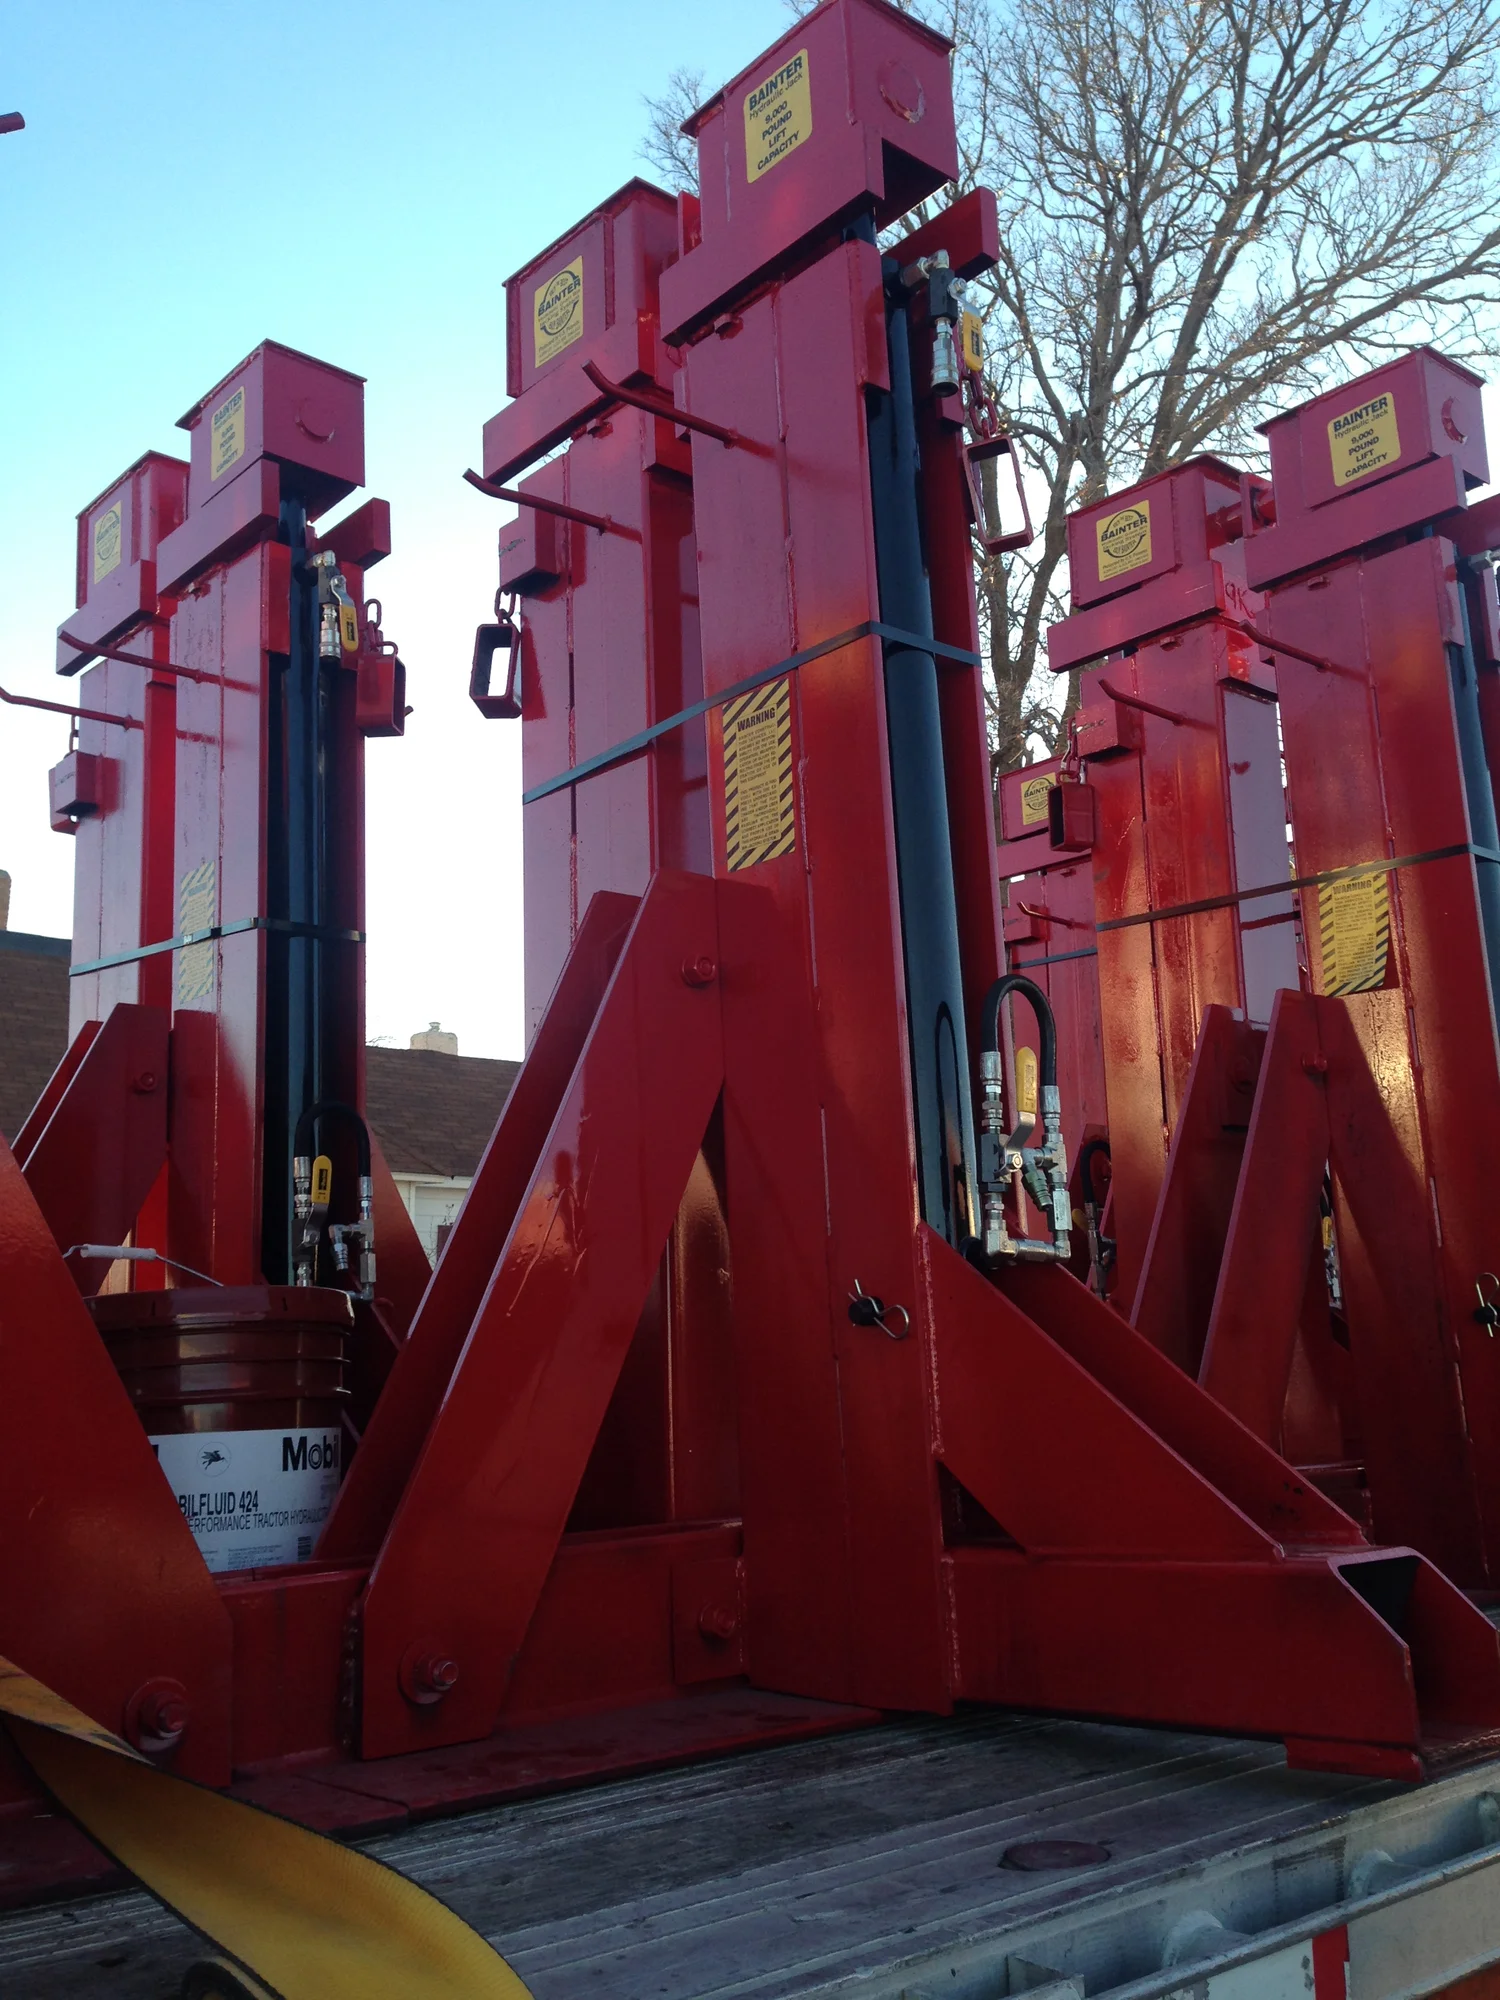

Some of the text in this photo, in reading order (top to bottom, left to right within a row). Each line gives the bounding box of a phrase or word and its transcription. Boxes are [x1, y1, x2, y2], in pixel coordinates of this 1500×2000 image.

[749, 56, 803, 111] BAINTER
[749, 72, 803, 120] Hydraulic Jack
[762, 110, 792, 141] POUND
[765, 101, 788, 124] 9,000
[757, 130, 799, 170] CAPACITY
[768, 127, 787, 148] LIFT
[538, 277, 581, 317] BAINTER
[1333, 397, 1389, 433] BAINTER
[1334, 408, 1389, 439] Hydraulic Jack
[1348, 436, 1380, 456] POUND
[1350, 428, 1375, 445] 9,000
[1344, 452, 1388, 479] CAPACITY
[1355, 448, 1375, 463] LIFT
[1101, 516, 1148, 542] BAINTER
[737, 707, 776, 732] WARNING
[1332, 880, 1372, 894] WARNING
[282, 1434, 339, 1472] Mobil
[178, 1490, 258, 1517] BILFLUID 424
[187, 1513, 250, 1534] ERFORMANCE
[253, 1511, 293, 1529] TRACTOR
